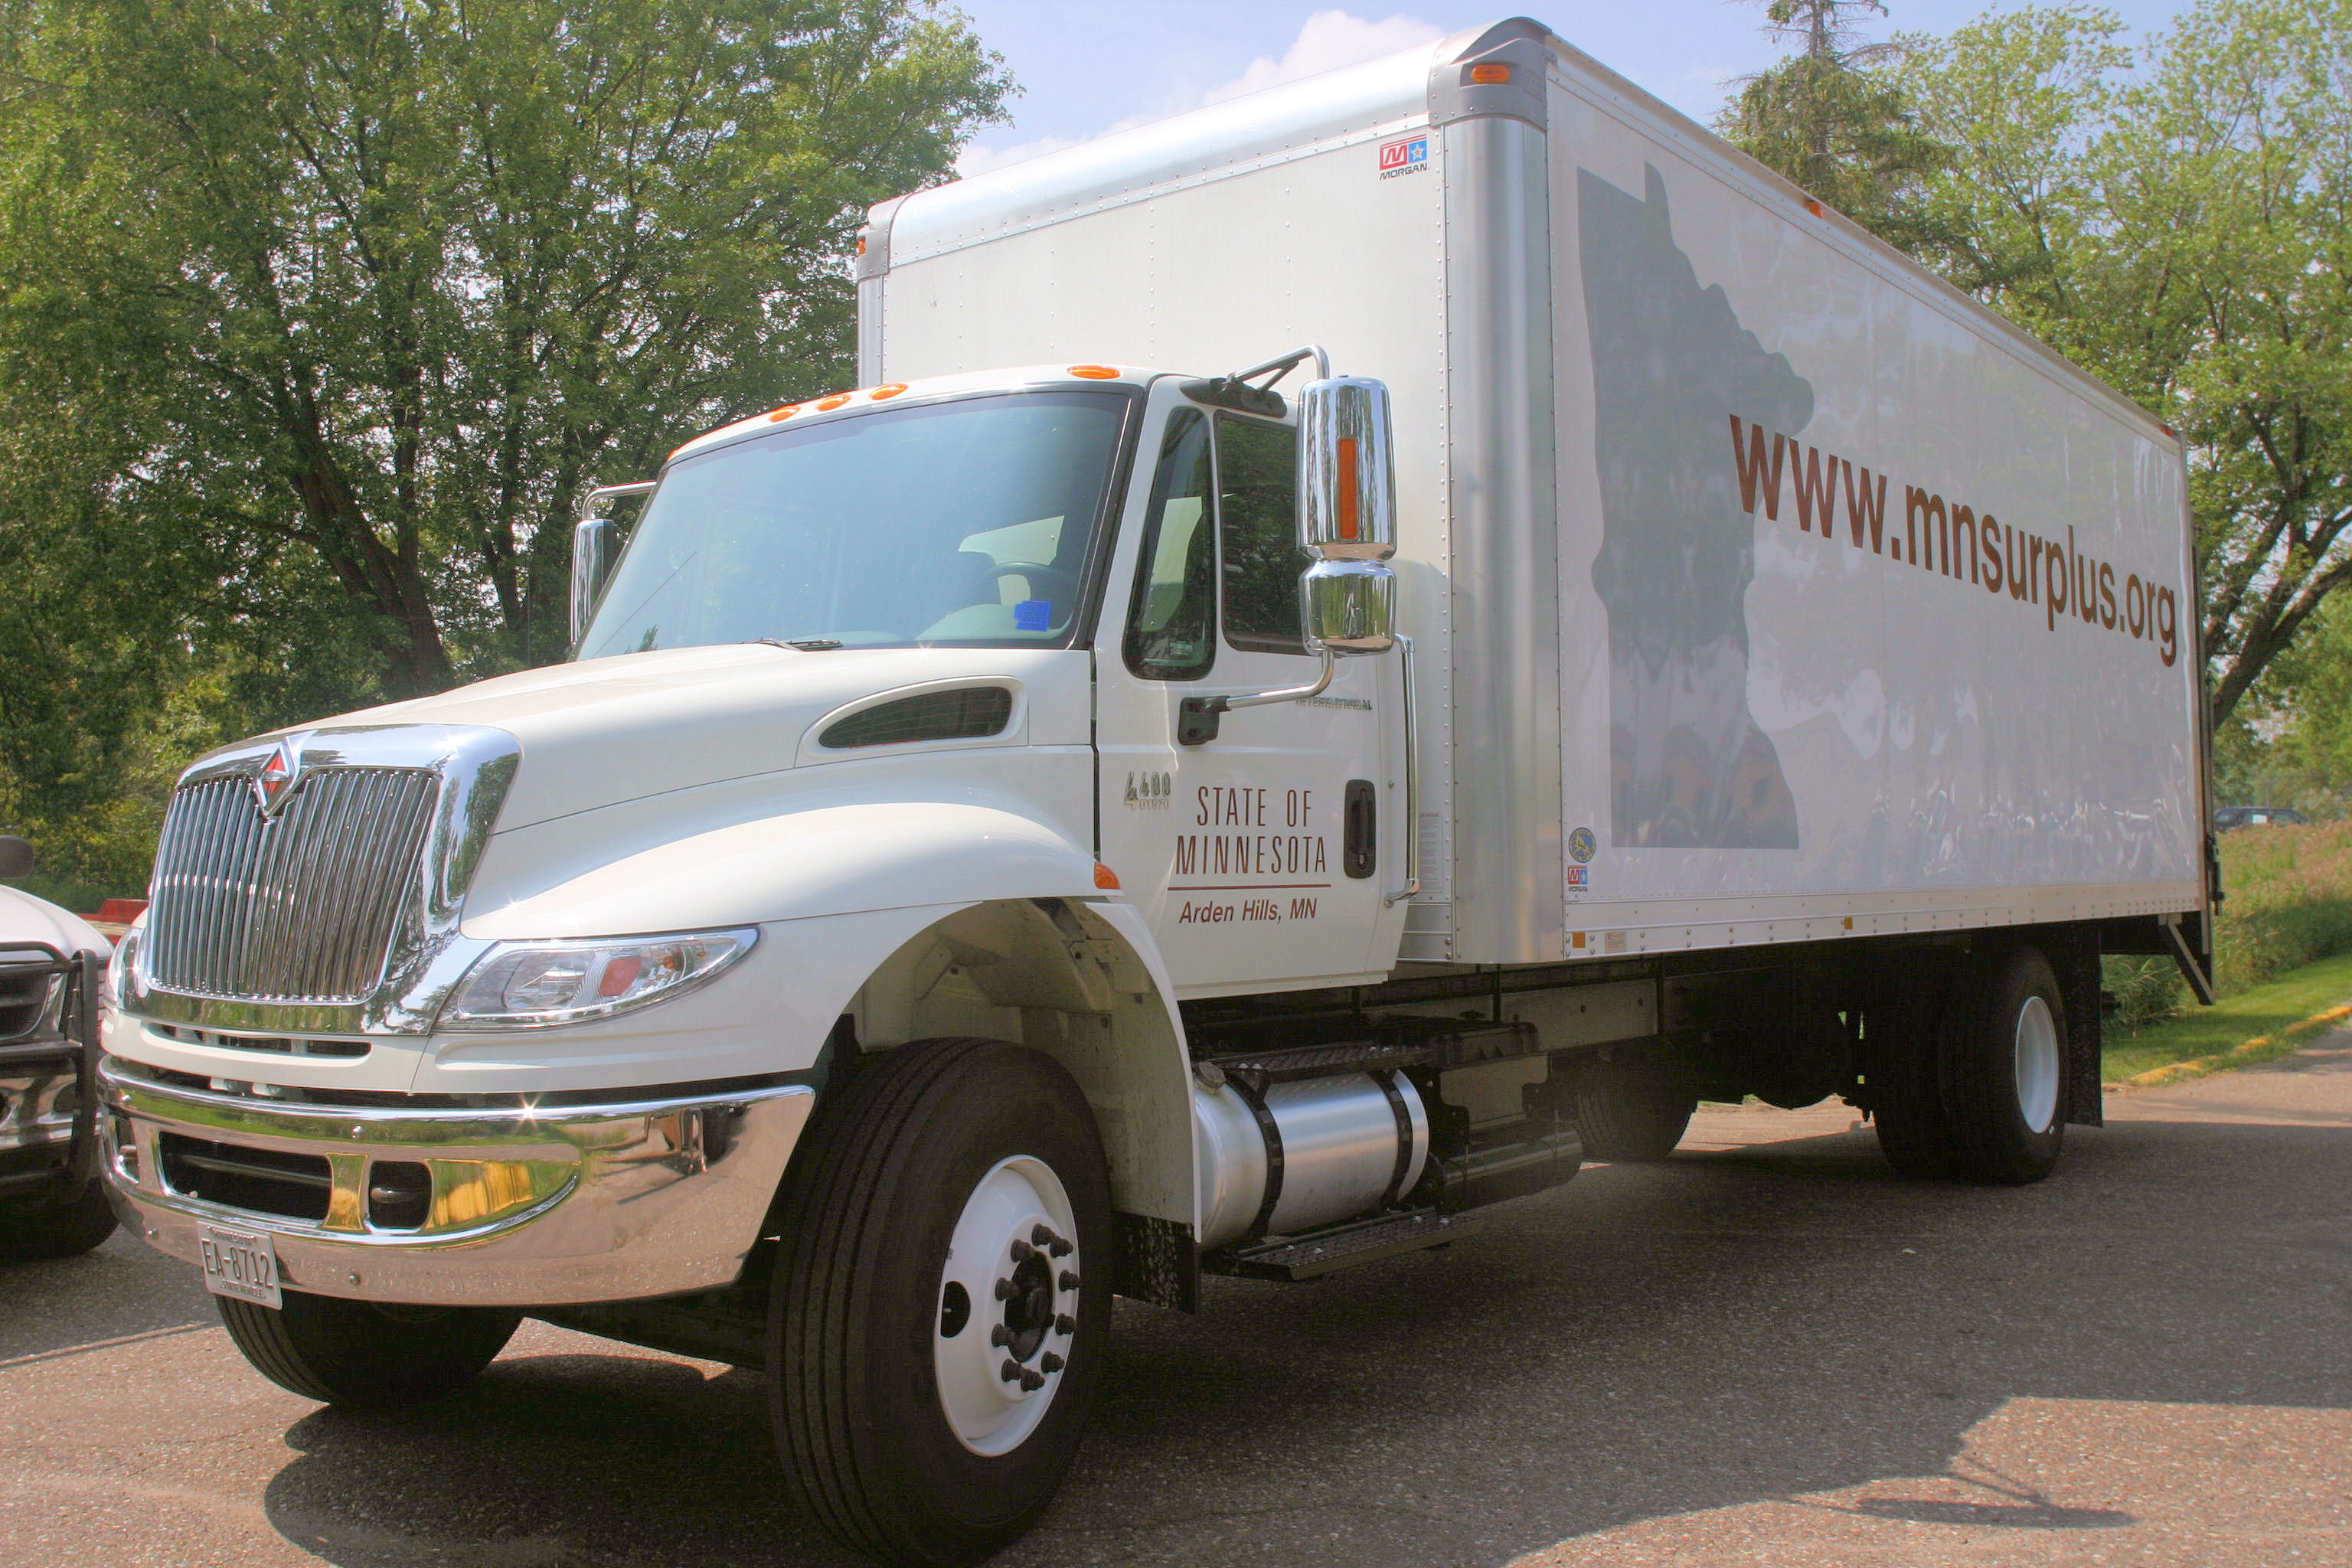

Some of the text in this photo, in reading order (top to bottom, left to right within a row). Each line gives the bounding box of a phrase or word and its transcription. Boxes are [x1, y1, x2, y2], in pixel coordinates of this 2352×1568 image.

[1379, 162, 1427, 181] MORGAN
[1730, 413, 2177, 667] www.mnsurplus.org
[1125, 771, 1171, 810] 4400
[1197, 786, 1312, 827] STATE OF
[1176, 835, 1326, 874] MINNESOTA
[1179, 898, 1317, 924] Arden Hills, MN
[201, 1237, 274, 1289] EA-8712
